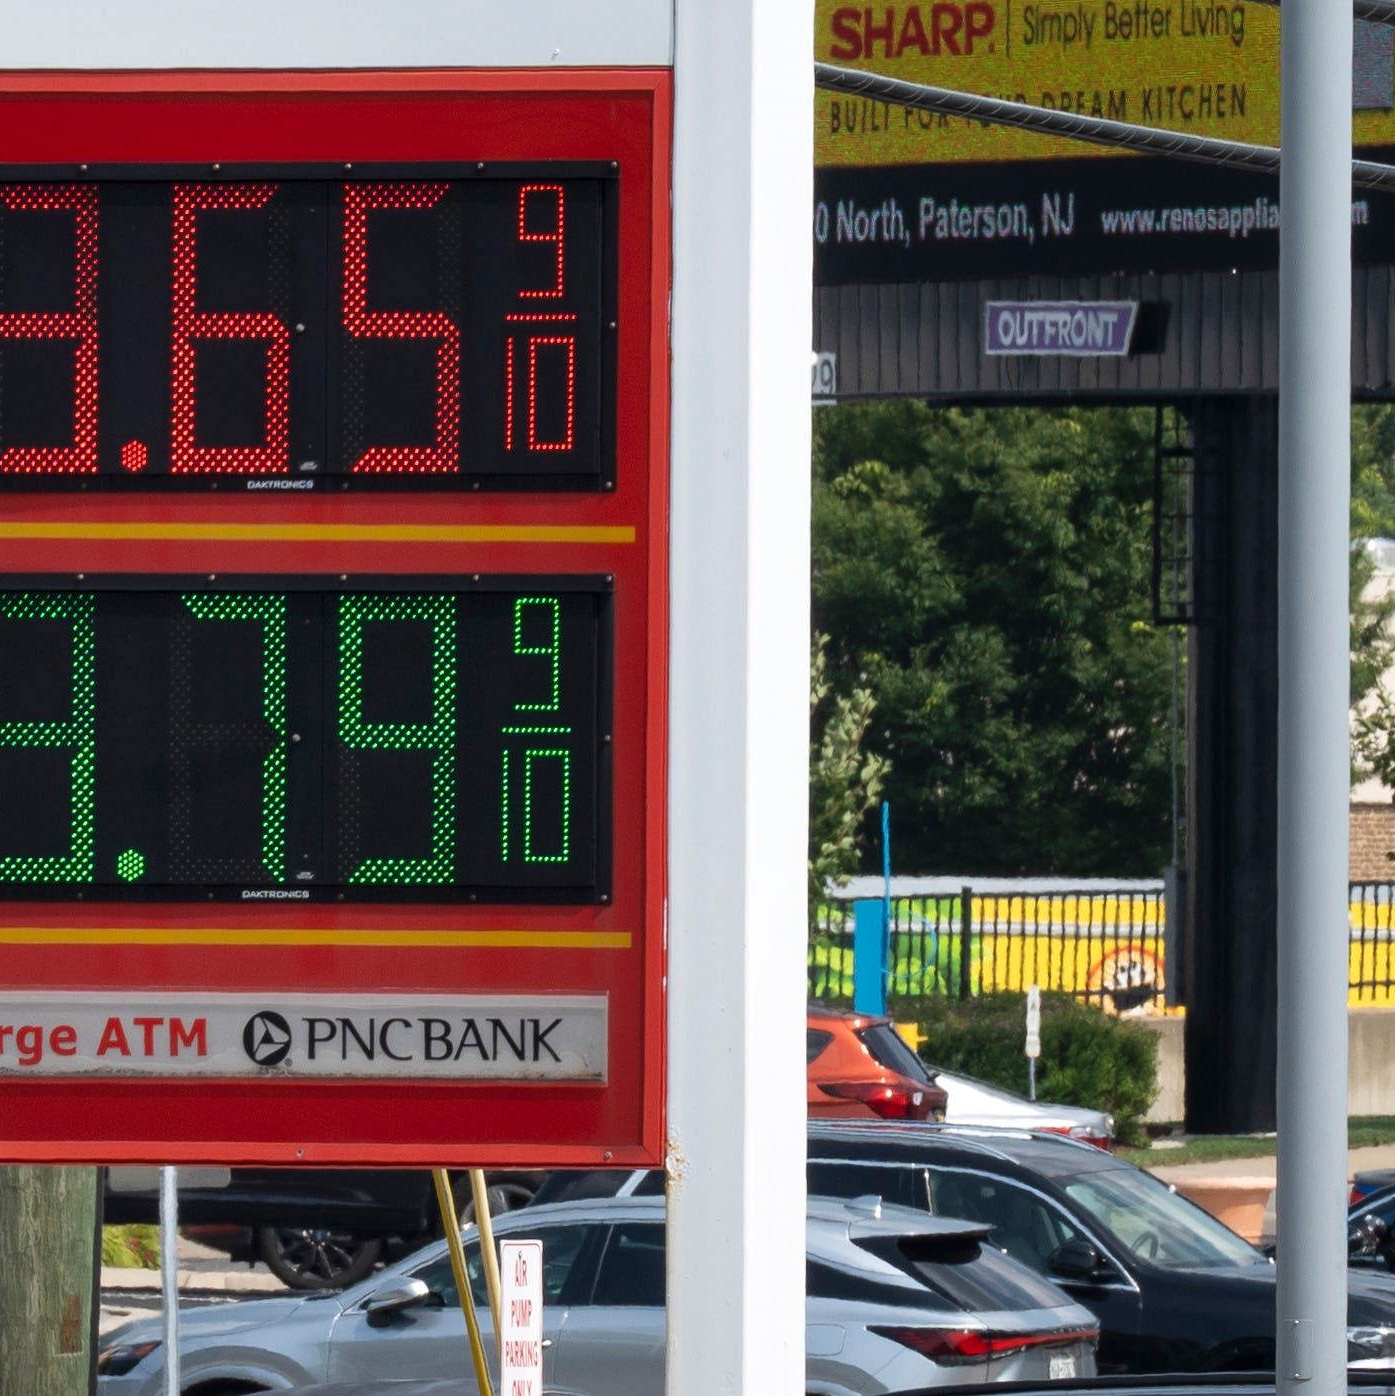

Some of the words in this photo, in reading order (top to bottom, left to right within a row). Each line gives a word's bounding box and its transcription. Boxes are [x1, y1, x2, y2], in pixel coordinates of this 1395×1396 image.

[1023, 4, 1095, 50] Simply
[1105, 2, 1172, 39] Better
[1181, 0, 1245, 47] Living
[831, 101, 889, 133] BUILT
[1142, 84, 1247, 121] KITCHEN
[837, 198, 911, 248] North,
[920, 197, 1035, 246] Paterson,
[1042, 192, 1075, 236] NJ
[998, 309, 1118, 347] OUTFRONT
[247, 480, 314, 489] DAKTRONICS
[242, 890, 310, 899] DAKTRONICS
[95, 1016, 209, 1058] ATM
[514, 1260, 528, 1287] AIR
[511, 1300, 532, 1327] PUMP
[505, 1340, 538, 1368] PARKING
